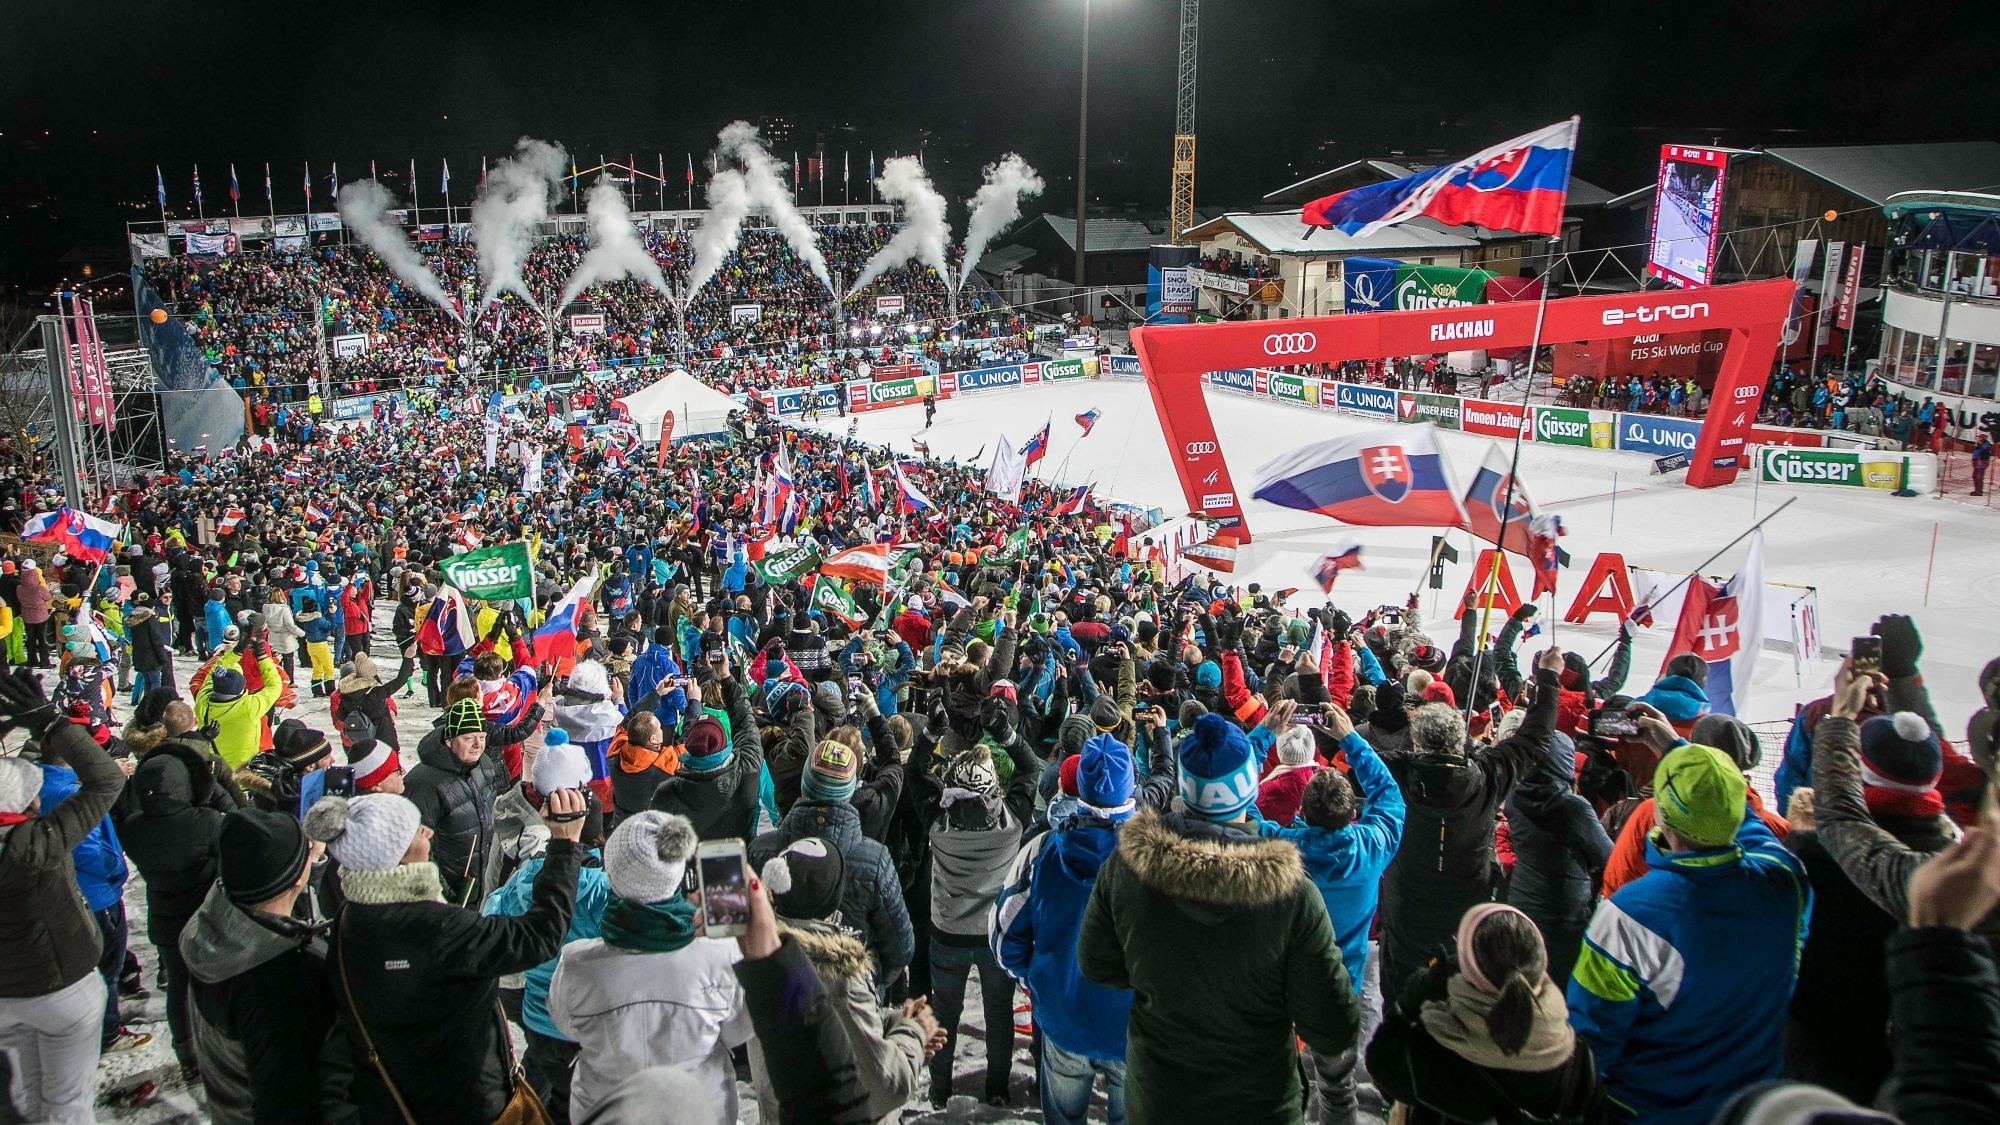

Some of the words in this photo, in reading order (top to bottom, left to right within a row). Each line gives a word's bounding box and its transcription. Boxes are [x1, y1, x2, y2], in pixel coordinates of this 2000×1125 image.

[1602, 302, 1709, 326] e-tron
[1430, 319, 1494, 342] FLACHAU
[1631, 348, 1649, 360] FIS
[1651, 346, 1667, 358] Ski
[1669, 343, 1701, 355] World
[1703, 341, 1723, 353] Cup
[1043, 361, 1081, 380] Gösser
[1122, 359, 1142, 373] UNIQ
[980, 371, 1019, 385] UNIQA
[1225, 371, 1253, 388] UNIQA
[1270, 375, 1303, 397] Gösser
[872, 383, 913, 402] Gösser
[1356, 392, 1393, 410] UNIQA
[338, 407, 352, 417] Fan
[353, 403, 371, 414] Zone
[1416, 404, 1439, 416] UNSER
[1440, 407, 1459, 419] HEER
[1465, 408, 1495, 426] Kronen
[1496, 410, 1531, 433] Zeitung
[1538, 411, 1587, 440] Gösser
[1652, 428, 1696, 450] UNIQ
[1767, 449, 1855, 482] Gösser
[764, 545, 812, 578] Gösser
[447, 561, 522, 592] Gösser
